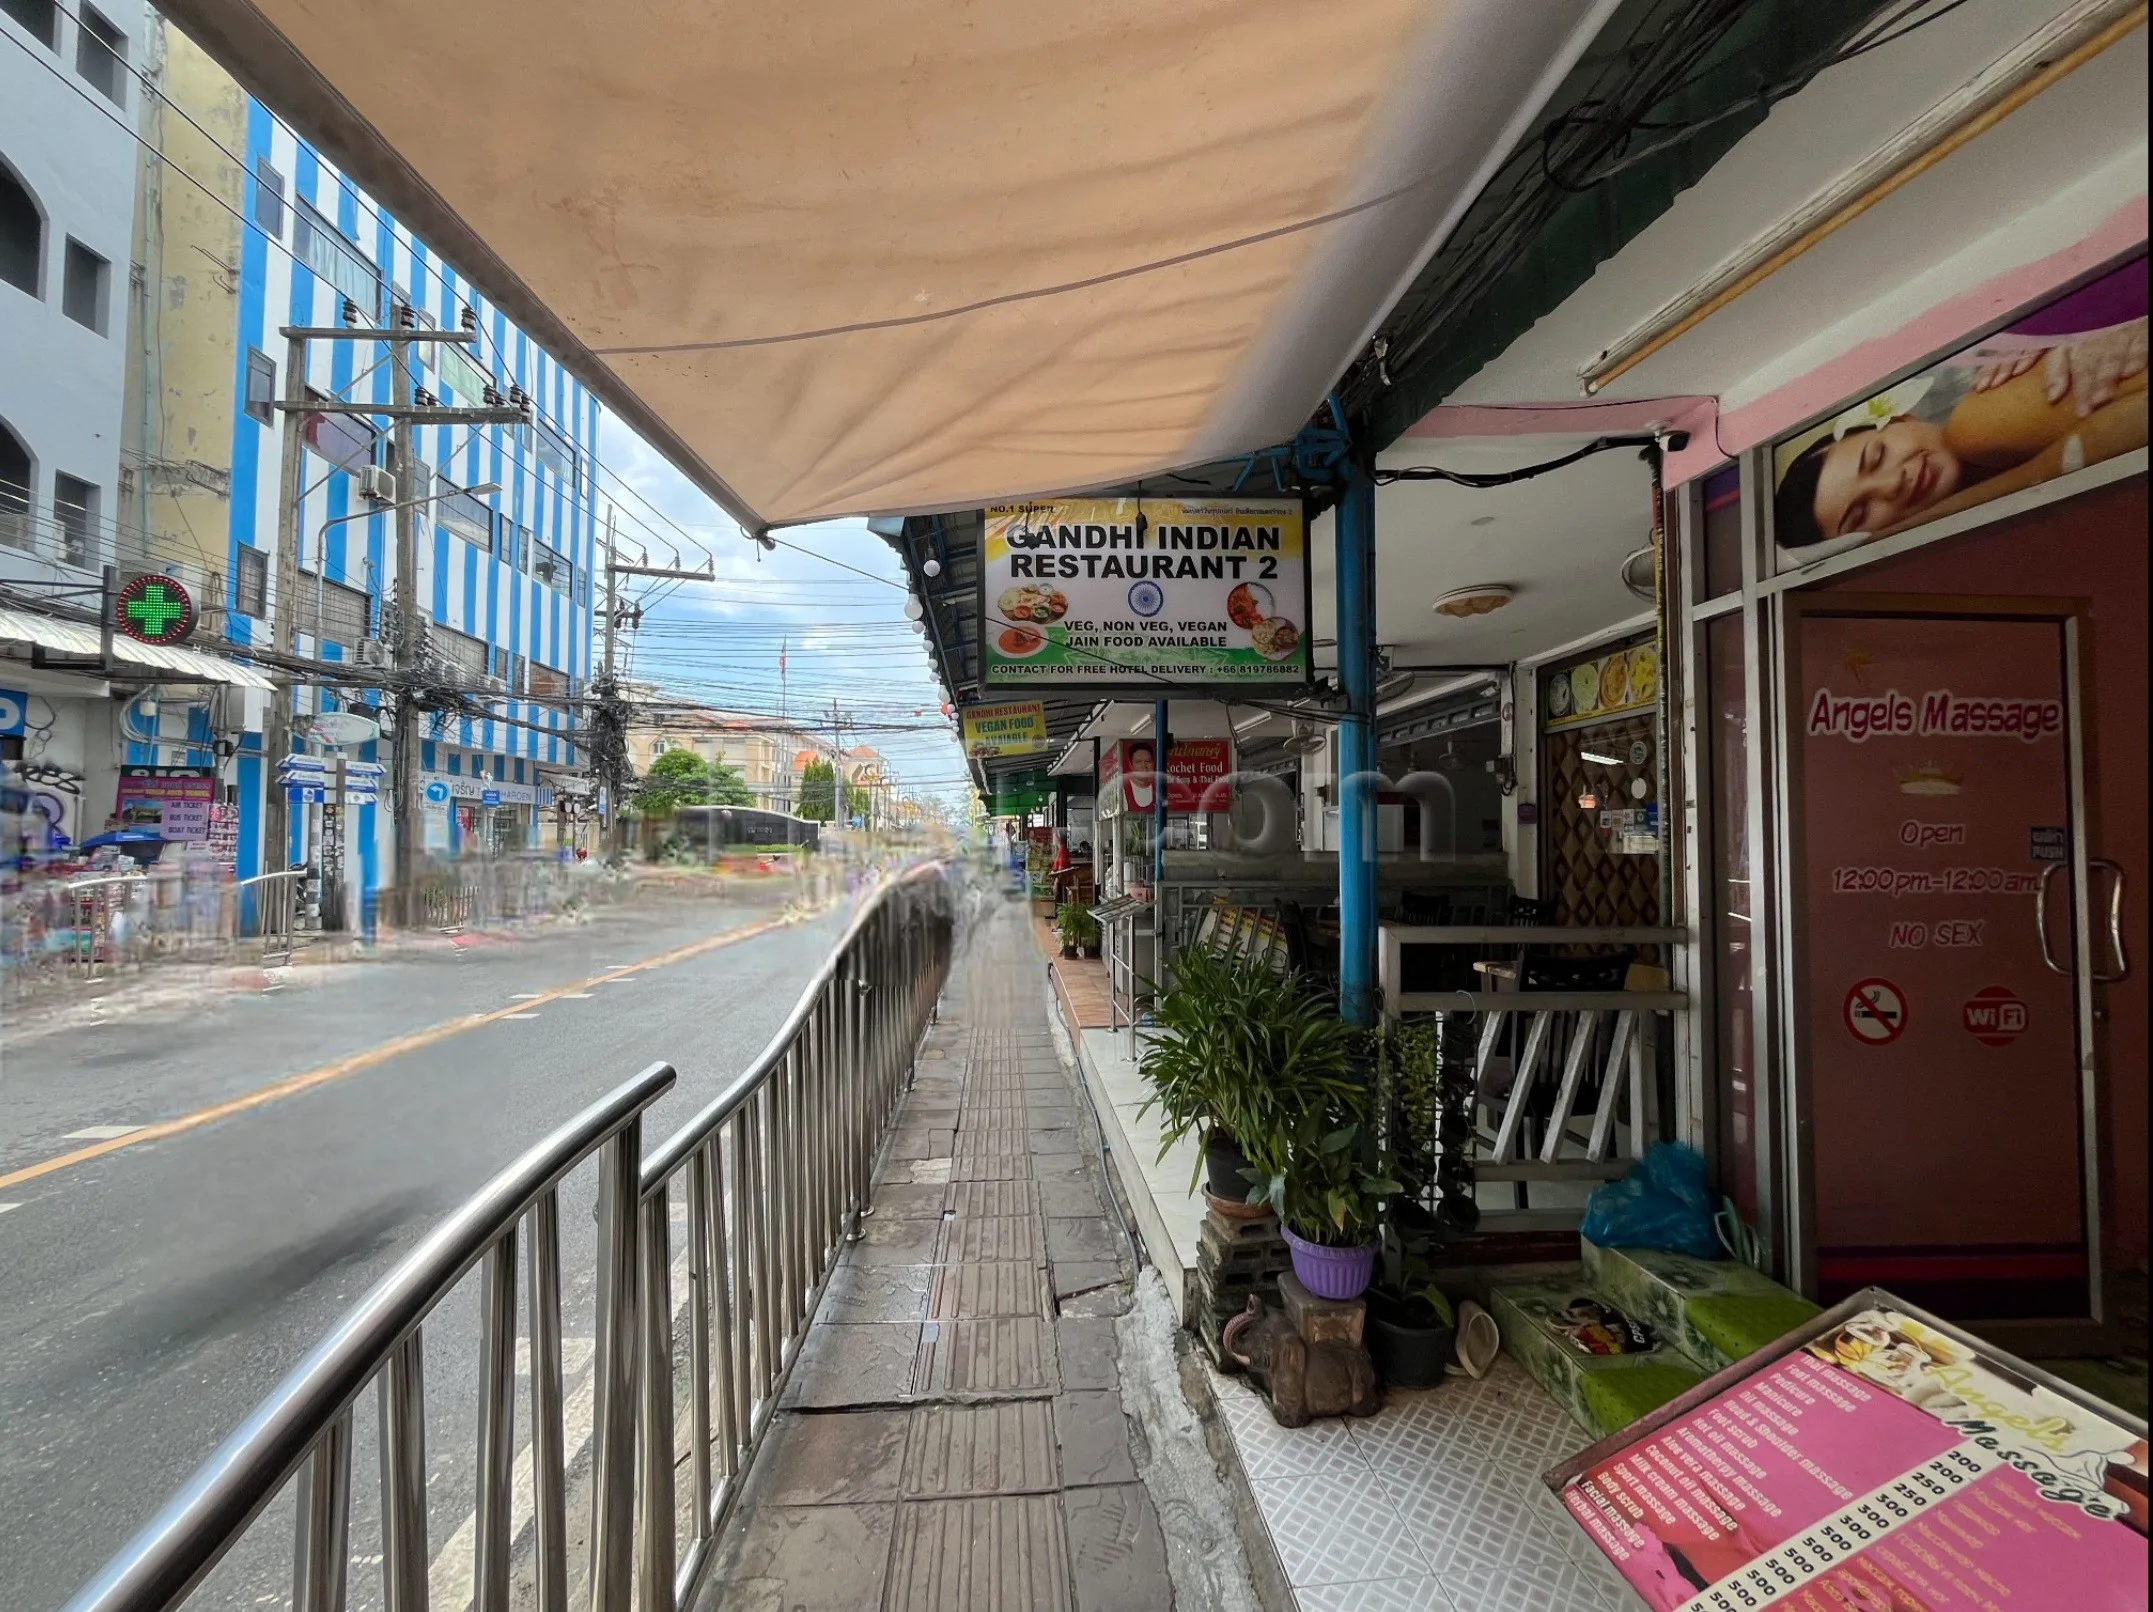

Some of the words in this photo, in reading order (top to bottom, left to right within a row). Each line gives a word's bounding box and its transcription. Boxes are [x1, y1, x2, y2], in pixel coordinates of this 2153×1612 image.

[989, 505, 1015, 514] NO.1
[1018, 505, 1055, 514] SUPER
[1006, 523, 1144, 550] GANDHI
[1158, 525, 1280, 551] INDIAN
[1010, 554, 1248, 580] RESTAURANT
[1259, 556, 1279, 579] 2
[1064, 620, 1099, 634] VEG,
[1103, 620, 1135, 632] NON
[1139, 620, 1174, 634] VEG,
[1177, 620, 1228, 632] VEGAN
[1065, 635, 1099, 648] JAIN
[1104, 635, 1144, 647] FOOD
[1148, 635, 1228, 647] AVAILABLE
[992, 664, 1047, 675] CONTACT
[1050, 664, 1076, 675] FOR
[1077, 664, 1106, 675] FREE
[1109, 664, 1148, 675] HOTEL
[1151, 665, 1207, 675] DELIVERY
[1216, 665, 1238, 675] +66
[994, 703, 1041, 717] RESTAURANT
[1810, 692, 1913, 739] Angels
[1921, 693, 2061, 740] Massage
[974, 718, 1007, 734] VEGAN
[1008, 715, 1034, 730] FOOD
[1199, 760, 1223, 774] Food
[183, 802, 203, 810] TICKET
[183, 814, 203, 822] TICKET
[187, 827, 205, 835] TICKET
[1899, 822, 1965, 849] Open
[2032, 845, 2064, 860] PUSH
[1889, 924, 1927, 948] NO
[1934, 920, 1985, 947] SEX
[1769, 1372, 1817, 1406] Pedicure
[1784, 1363, 1810, 1384] Foot
[1807, 1375, 1858, 1413] massage
[1800, 1354, 1822, 1372] Thai
[1820, 1365, 1873, 1403] massage
[1738, 1390, 1755, 1408] Oil
[1750, 1399, 1799, 1436] massage
[1753, 1381, 1804, 1418] Manicure
[1707, 1407, 1733, 1429] Foot
[1726, 1423, 1759, 1449] scrub
[1691, 1417, 1710, 1434] Hot
[1706, 1429, 1723, 1444] oil
[1719, 1436, 1768, 1481] massage
[1722, 1399, 1749, 1421] Head
[1753, 1422, 1803, 1463] Shoulder
[1798, 1457, 1855, 1500] massage
[1947, 1450, 1982, 1474] 200
[1660, 1434, 1683, 1456] Aloe
[1679, 1448, 1705, 1474] vera
[1699, 1470, 1747, 1512] massage
[1929, 1460, 1964, 1485] 200
[1945, 1419, 2112, 1520] Massage
[1597, 1470, 1621, 1497] Body
[1615, 1489, 1645, 1519] scrub
[1613, 1461, 1637, 1489] Sport
[1632, 1480, 1677, 1526] massage
[1629, 1452, 1650, 1476] Milk
[1646, 1470, 1678, 1500] cream
[1672, 1493, 1722, 1542] massage
[1644, 1443, 1686, 1484] Coconut
[1681, 1472, 1697, 1492] oil
[1691, 1482, 1739, 1531] massage
[1731, 1472, 1784, 1518] massage
[1893, 1482, 1927, 1508] 250
[1911, 1471, 1946, 1496] 250
[1580, 1480, 1607, 1511] Facial
[1602, 1504, 1647, 1550] massage
[1857, 1503, 1890, 1529] 300
[1875, 1493, 1909, 1519] 300
[1563, 1489, 1593, 1521] Herbal
[1587, 1513, 1631, 1562] massage
[1820, 1525, 1852, 1552] 500
[1838, 1514, 1873, 1541] 300
[1783, 1547, 1816, 1574] 500
[1802, 1536, 1834, 1563] 500
[1746, 1568, 1778, 1597] 500
[1765, 1558, 1797, 1585] 500
[1727, 1579, 1758, 1608] 500
